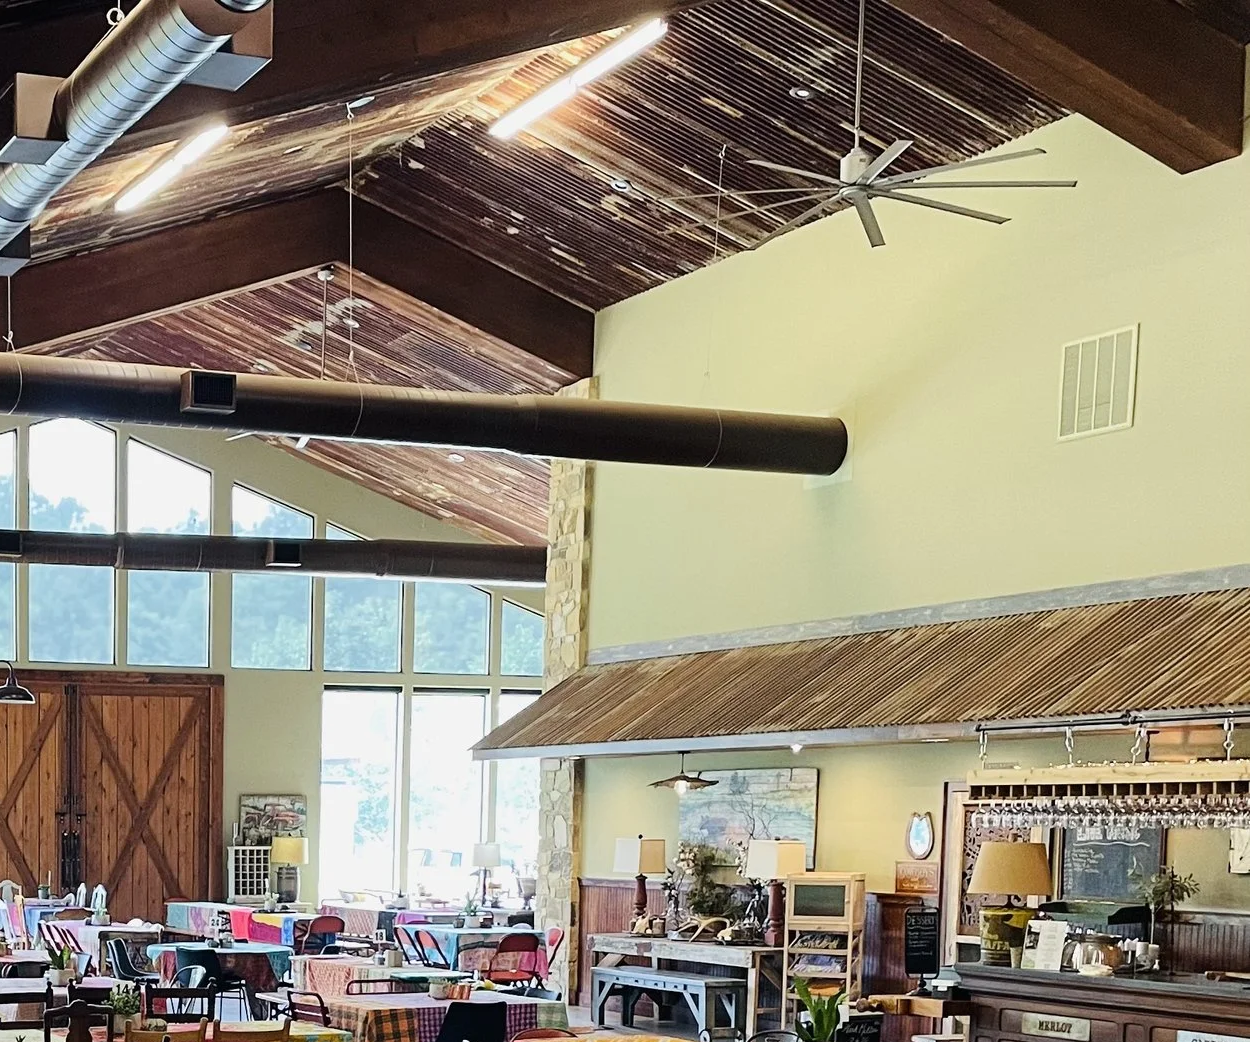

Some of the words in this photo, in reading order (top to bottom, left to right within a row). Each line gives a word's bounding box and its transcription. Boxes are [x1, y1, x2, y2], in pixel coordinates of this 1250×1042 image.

[375, 931, 384, 941] 18
[115, 983, 129, 995] 14
[1038, 1020, 1072, 1034] MERLOT
